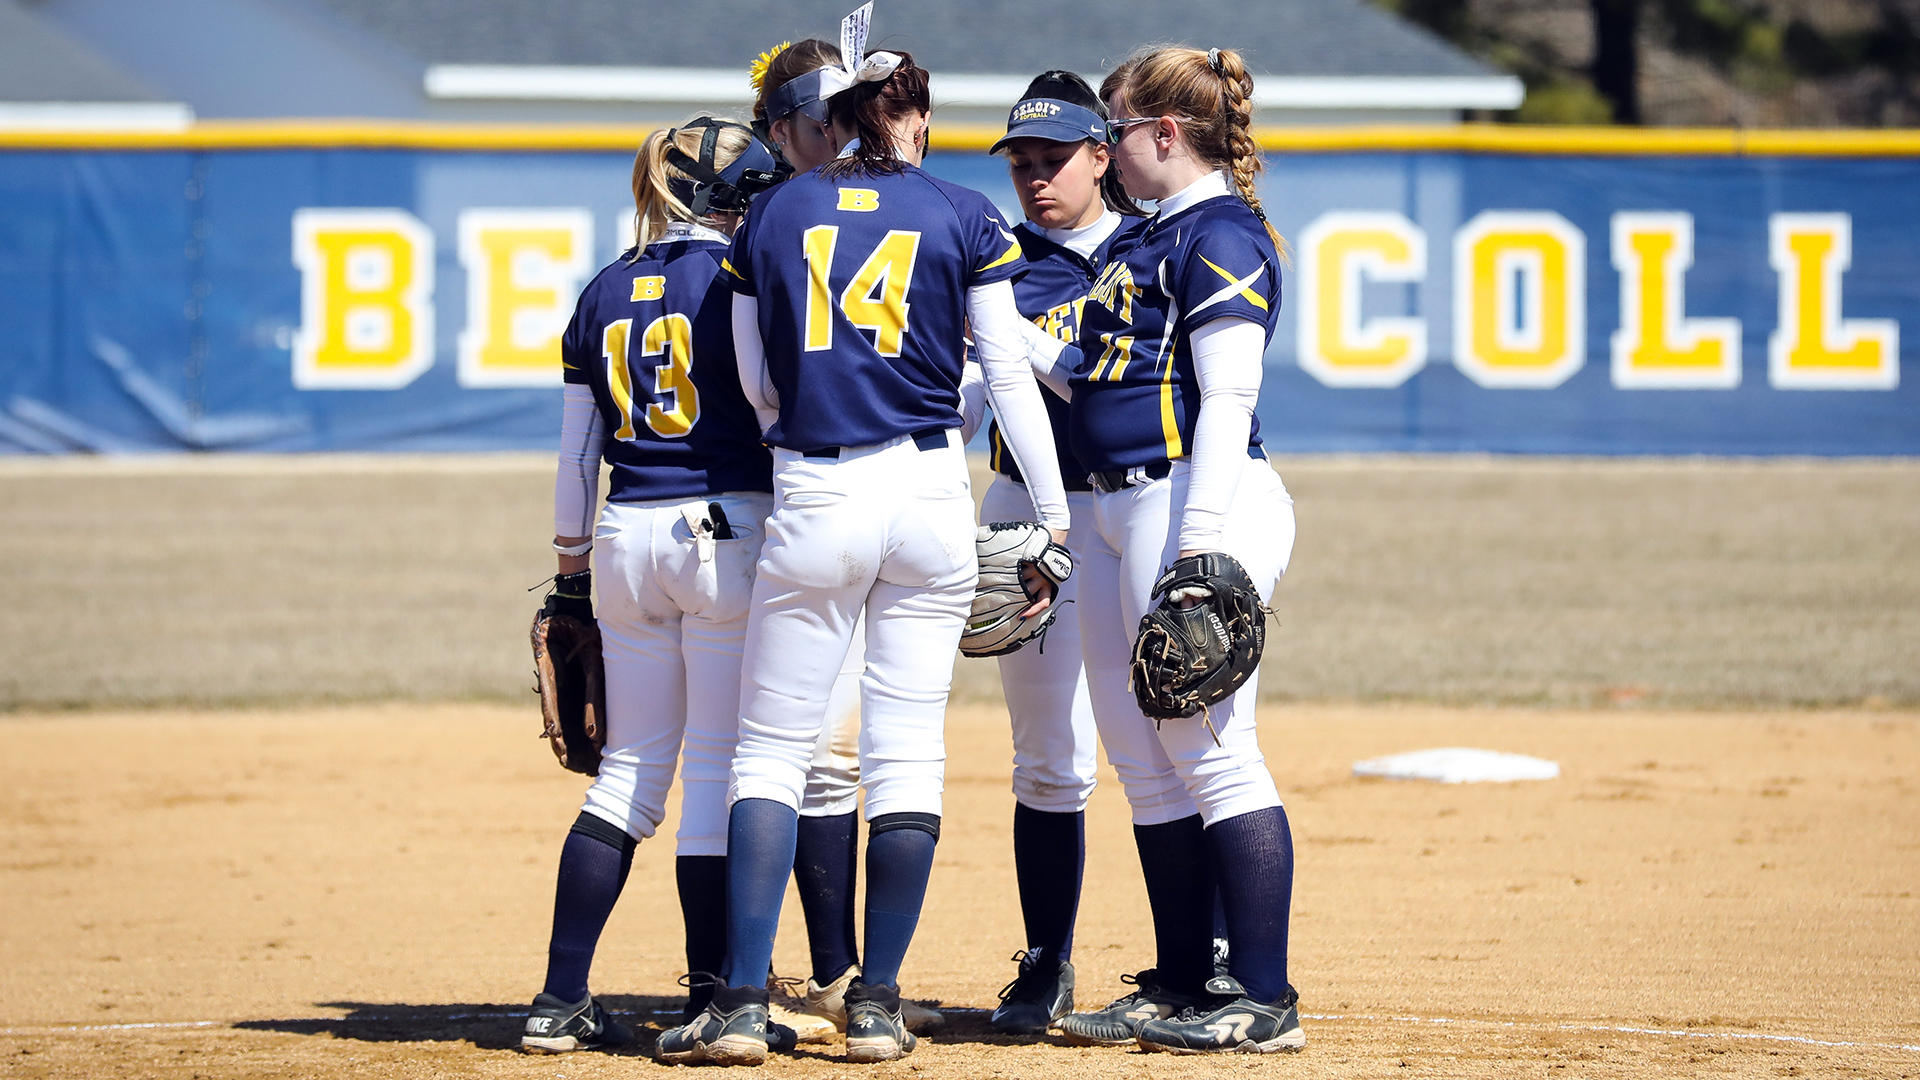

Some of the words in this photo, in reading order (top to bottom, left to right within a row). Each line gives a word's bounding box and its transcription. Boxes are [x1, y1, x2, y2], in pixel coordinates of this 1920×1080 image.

[1013, 101, 1061, 121] BELOIT
[1019, 112, 1049, 121] SOFTBALL
[836, 187, 880, 212] B
[665, 228, 707, 238] RMOUR
[292, 207, 640, 389] BE
[1297, 209, 1901, 390] COLL
[630, 275, 667, 302] B
[803, 224, 922, 358] 14
[1088, 332, 1135, 382] 11
[602, 312, 701, 442] 13
[525, 1016, 554, 1033] NIKE
